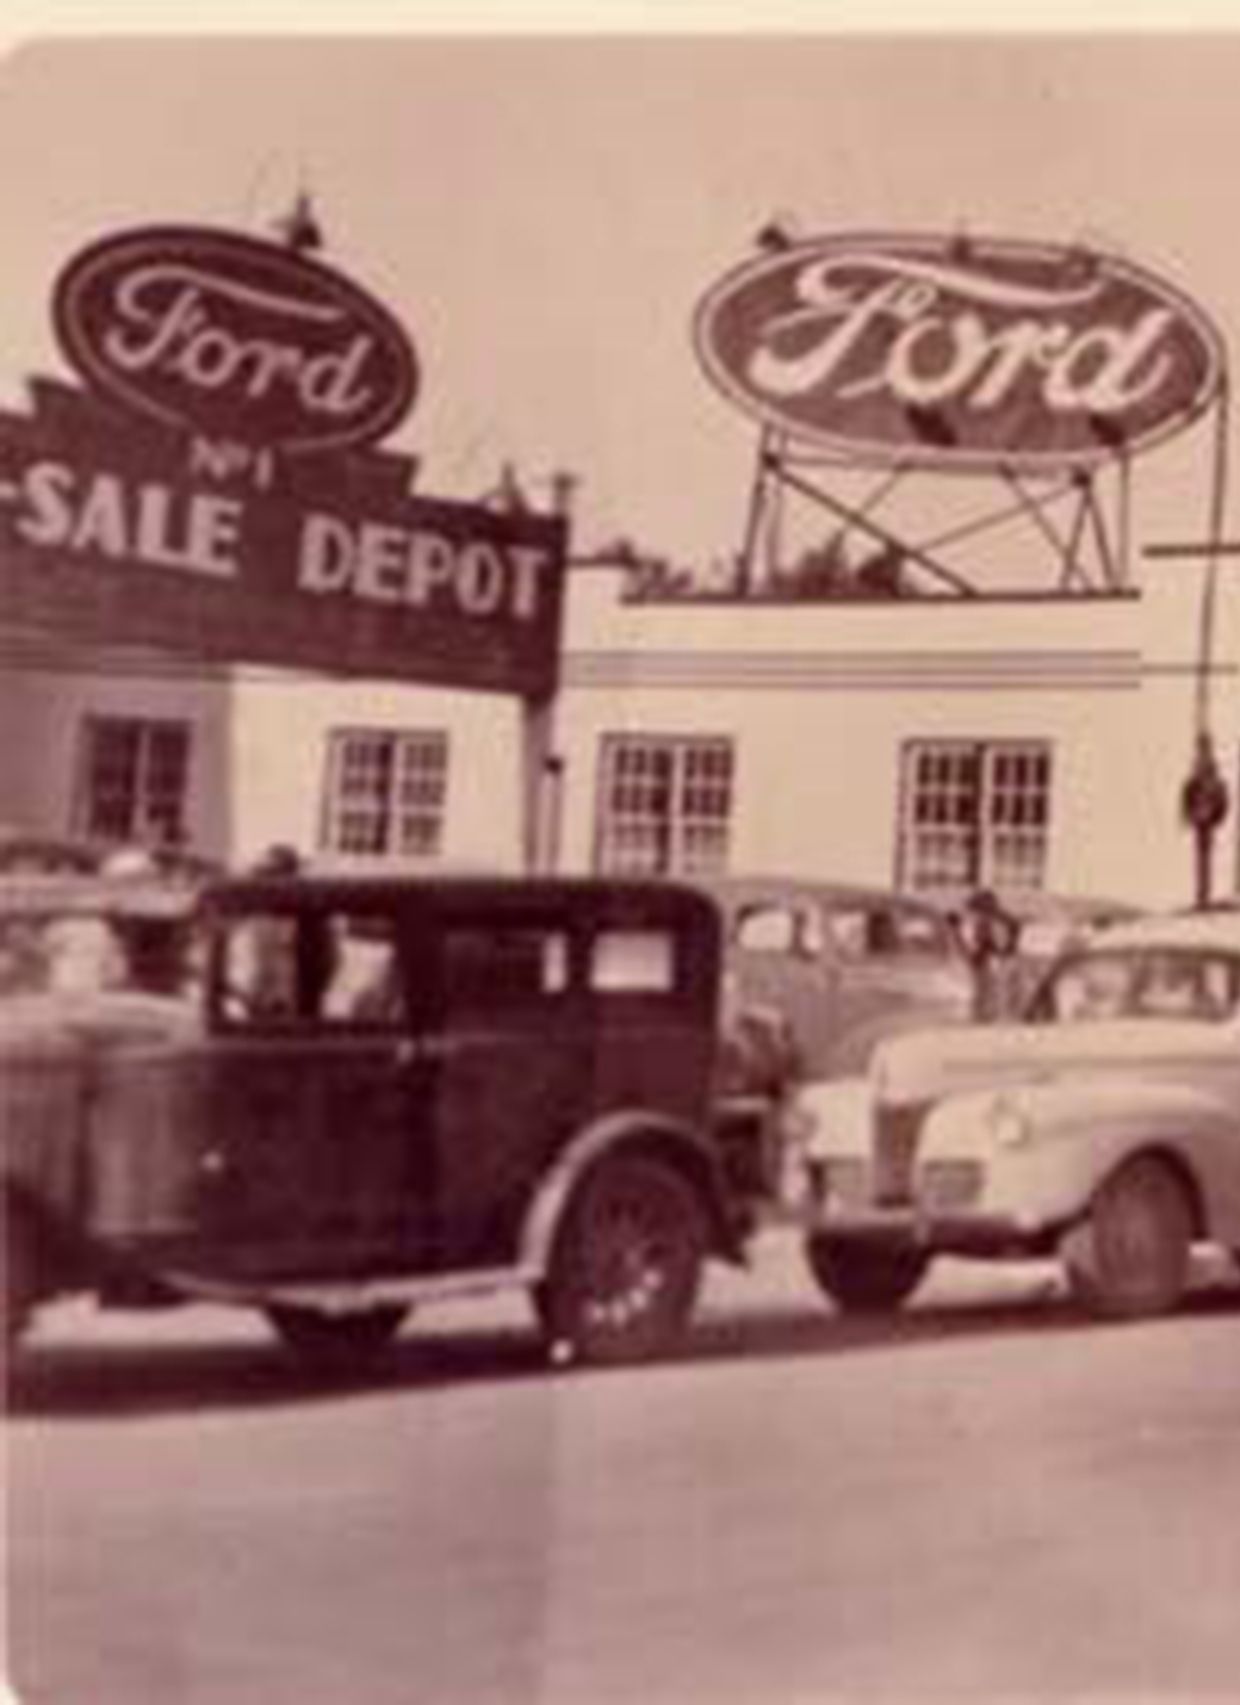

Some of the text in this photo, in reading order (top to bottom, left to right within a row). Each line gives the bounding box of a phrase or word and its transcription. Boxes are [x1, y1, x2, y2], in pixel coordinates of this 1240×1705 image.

[104, 264, 374, 412] Ford
[747, 253, 1176, 412] Ford
[297, 511, 548, 620] DEPOT
